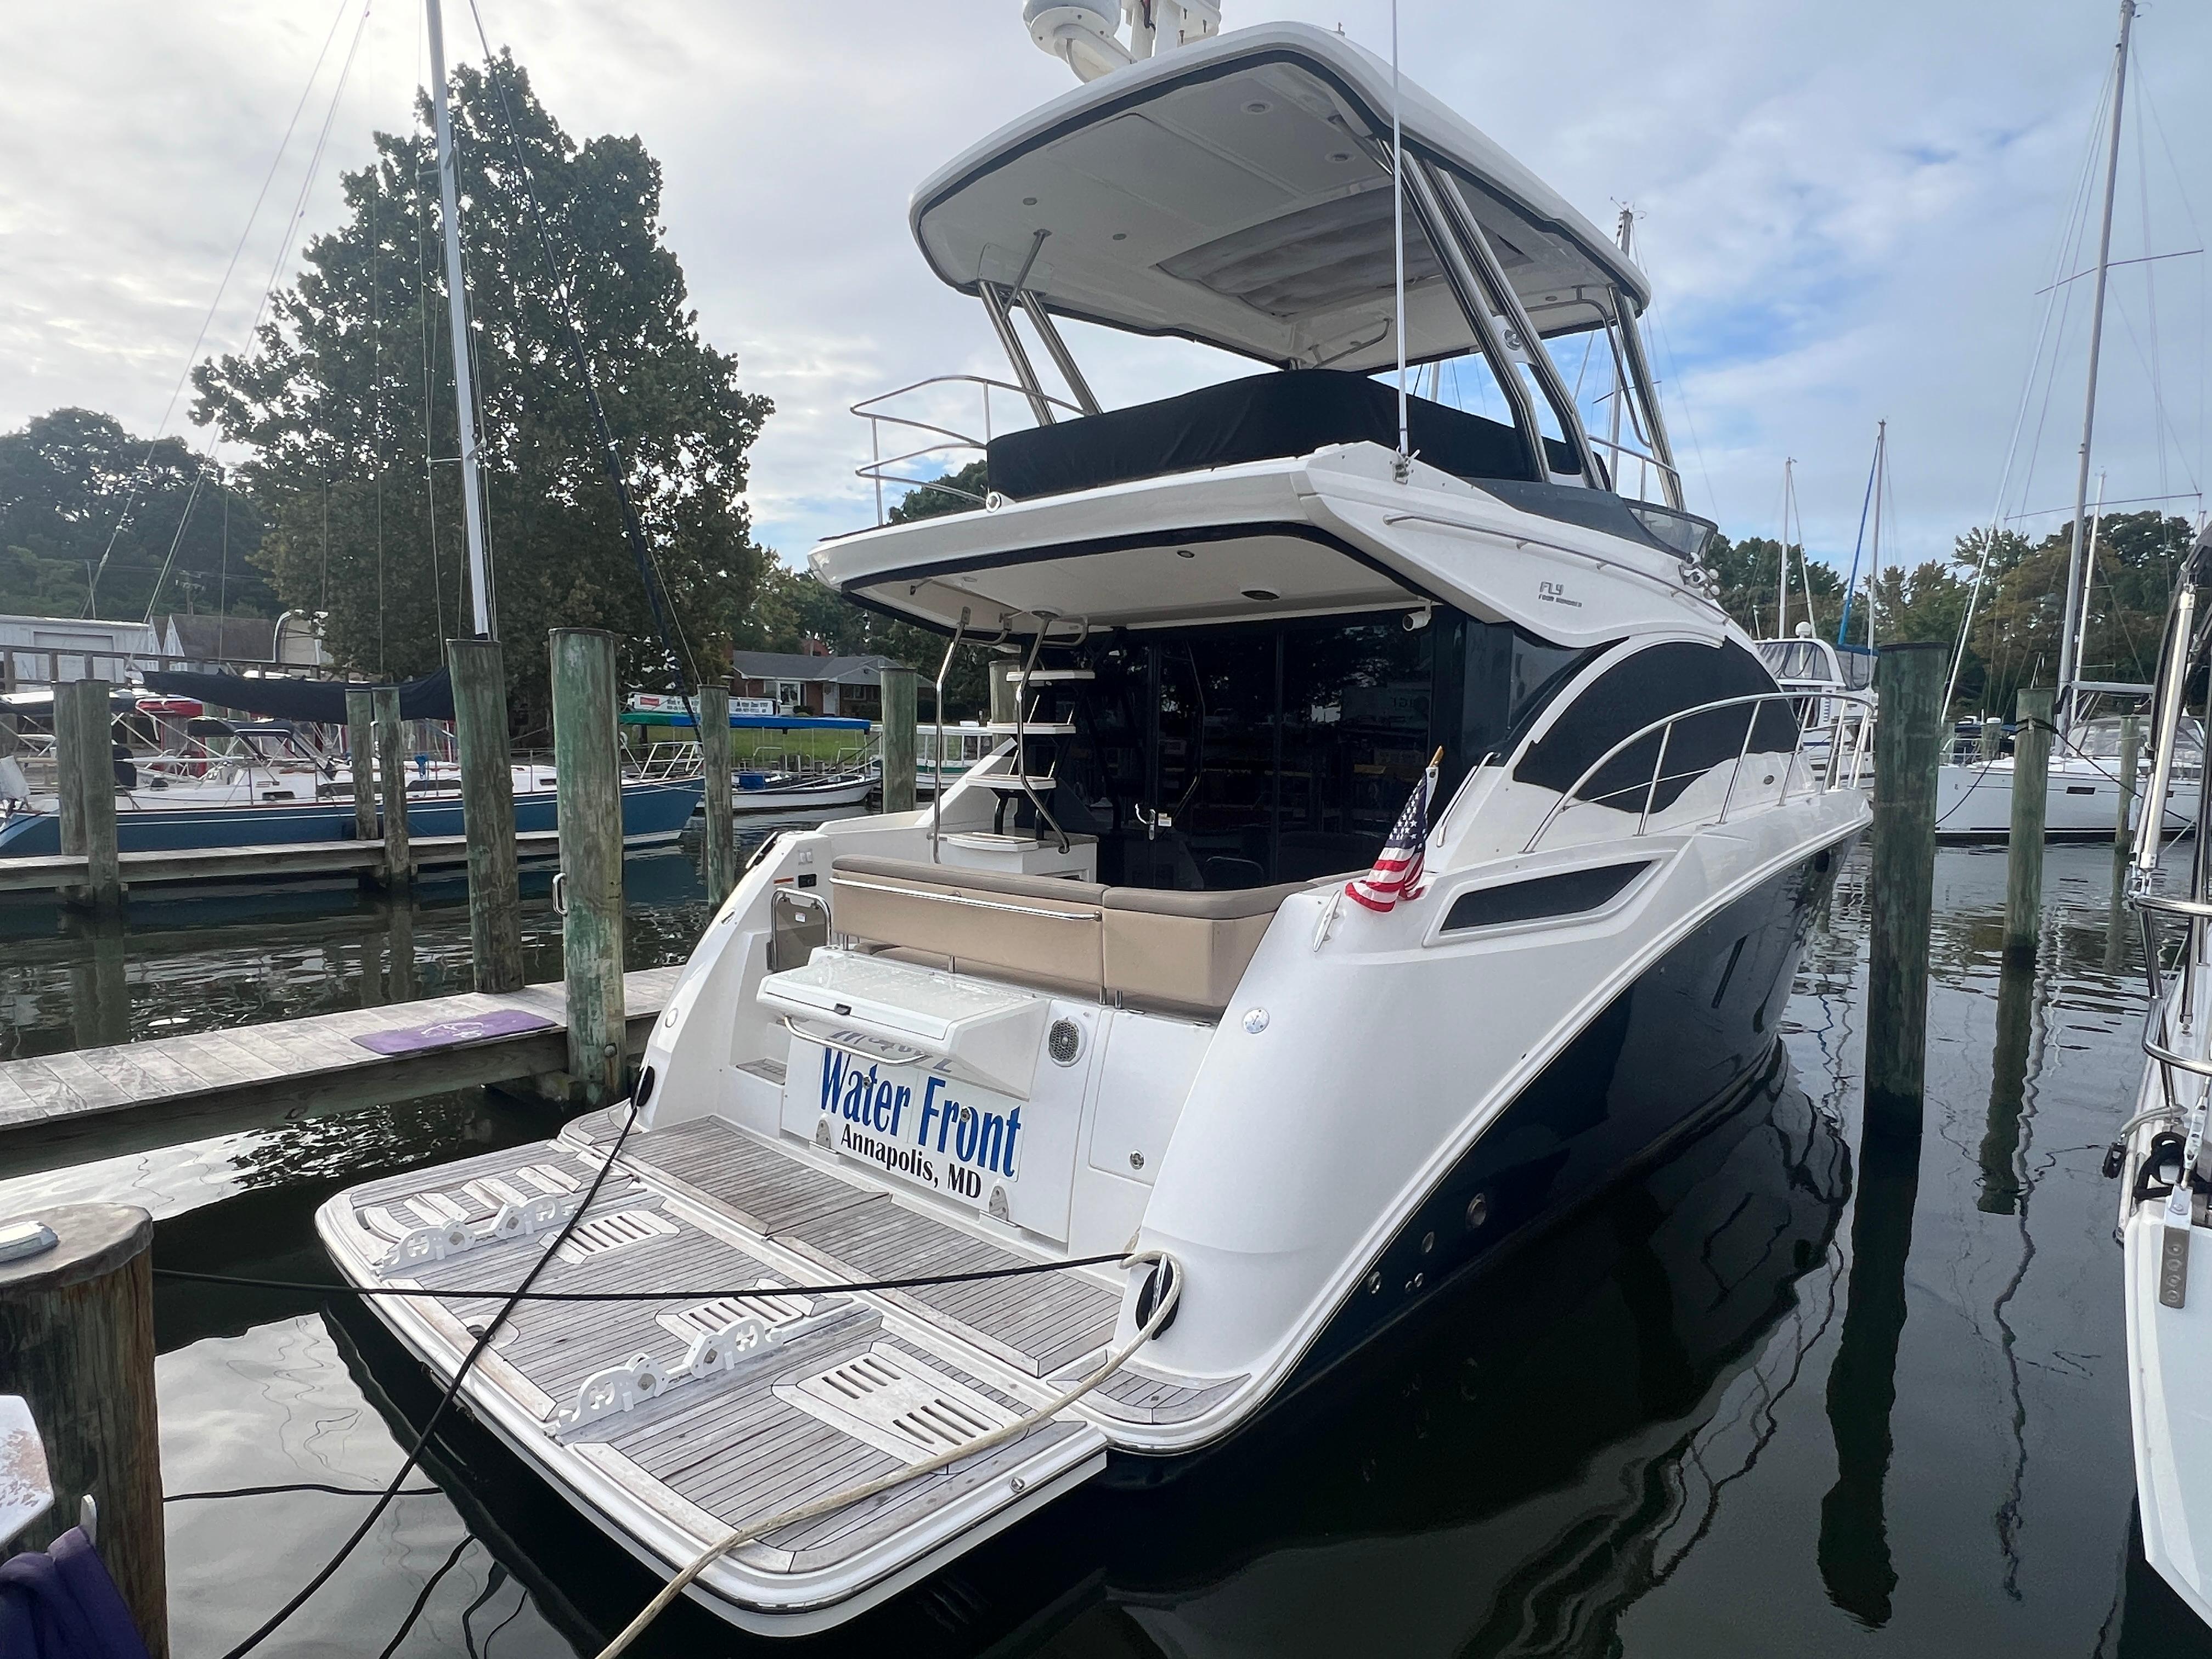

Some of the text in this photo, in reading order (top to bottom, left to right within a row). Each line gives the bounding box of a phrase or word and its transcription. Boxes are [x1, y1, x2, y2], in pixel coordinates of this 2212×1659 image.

[1539, 582, 1564, 595] FLY
[821, 1046, 1022, 1178] Water Front
[840, 1123, 981, 1199] Annapolis, MD
